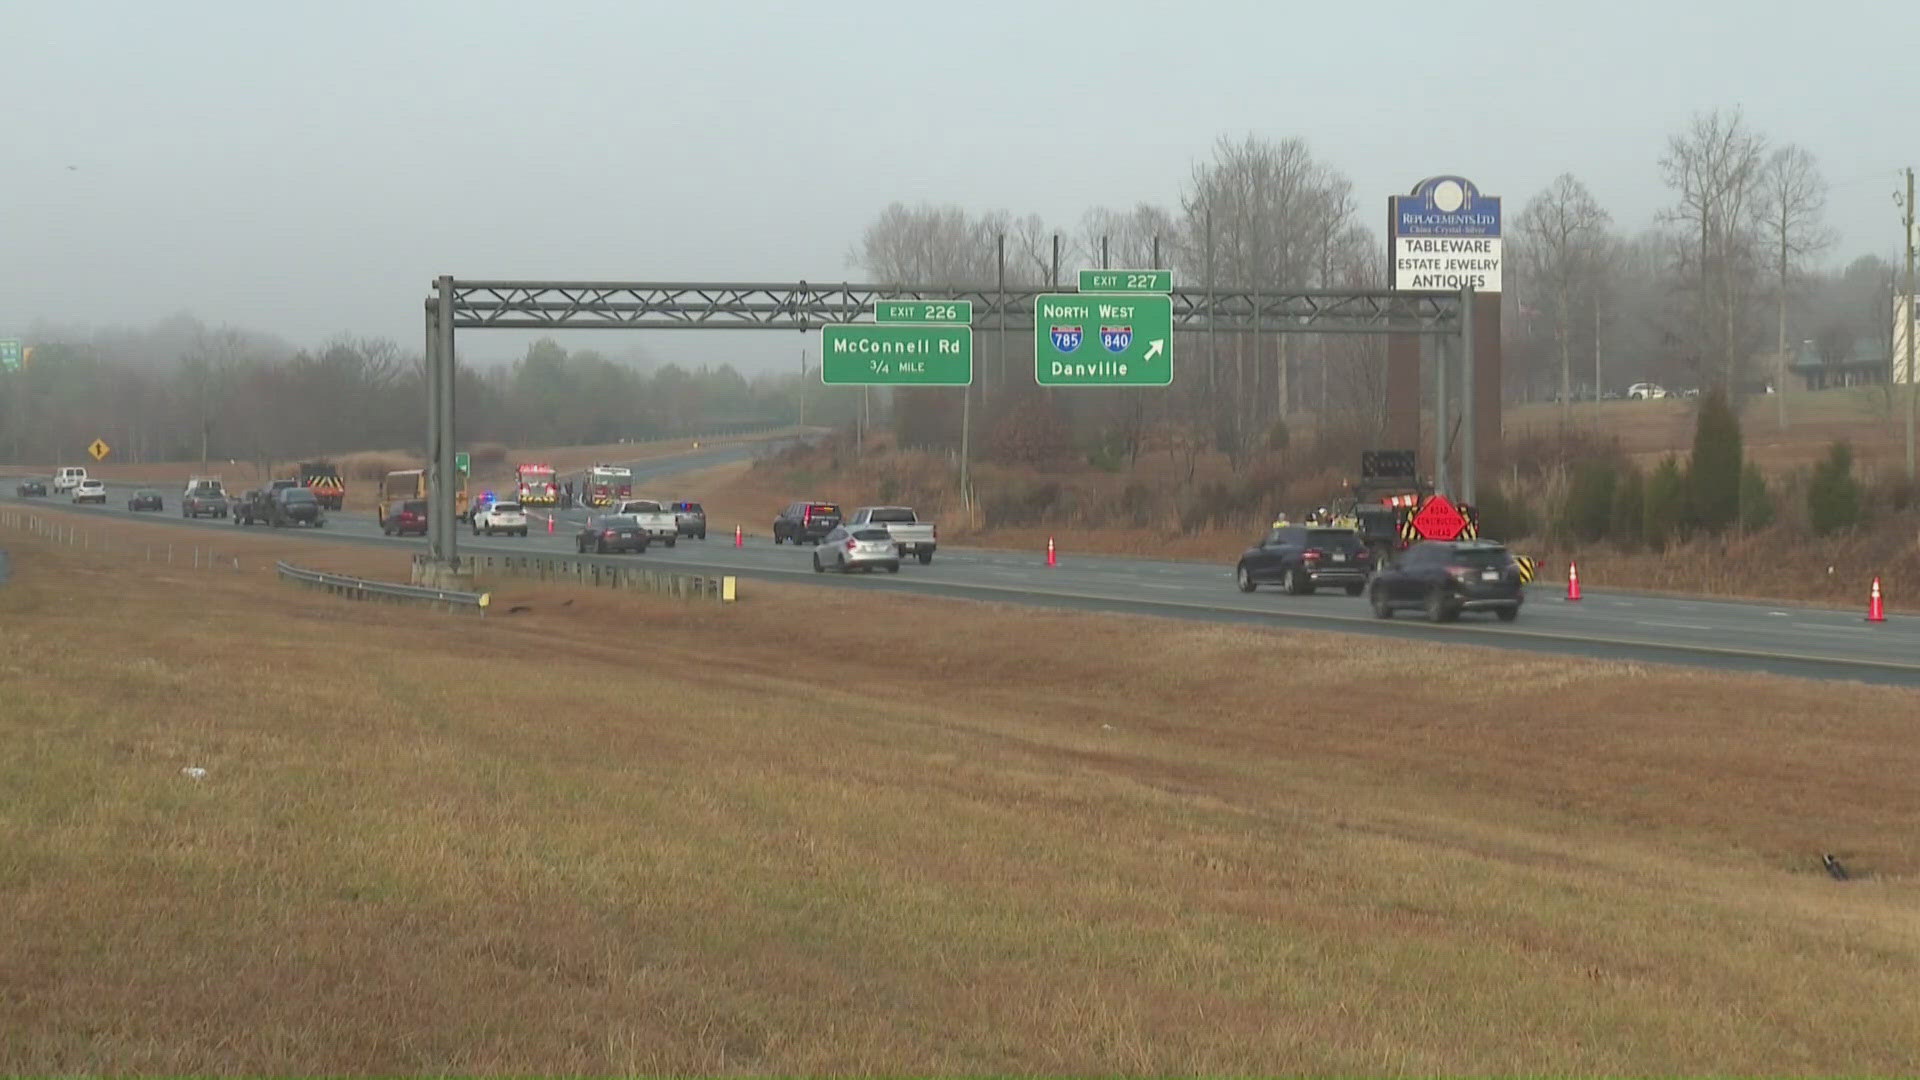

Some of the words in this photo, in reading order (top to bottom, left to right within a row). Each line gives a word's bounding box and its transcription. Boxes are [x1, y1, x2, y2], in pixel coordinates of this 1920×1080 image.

[1405, 240, 1491, 253] TABLEWARE
[1398, 259, 1441, 270] ESTATE
[1444, 259, 1499, 271] JEWELRY
[1094, 276, 1118, 286] EXIT
[1127, 275, 1157, 288] 227
[1412, 274, 1485, 288] ANTIQUES
[890, 307, 915, 317] EXIT
[925, 305, 957, 319] 226
[1044, 304, 1089, 318] NORTH
[1099, 304, 1134, 318] WEST
[834, 339, 930, 353] McConnell
[939, 339, 960, 353] Rd
[1055, 334, 1078, 347] 785
[1104, 334, 1128, 347] 840
[899, 362, 925, 372] MILE
[1052, 362, 1128, 376] Danville
